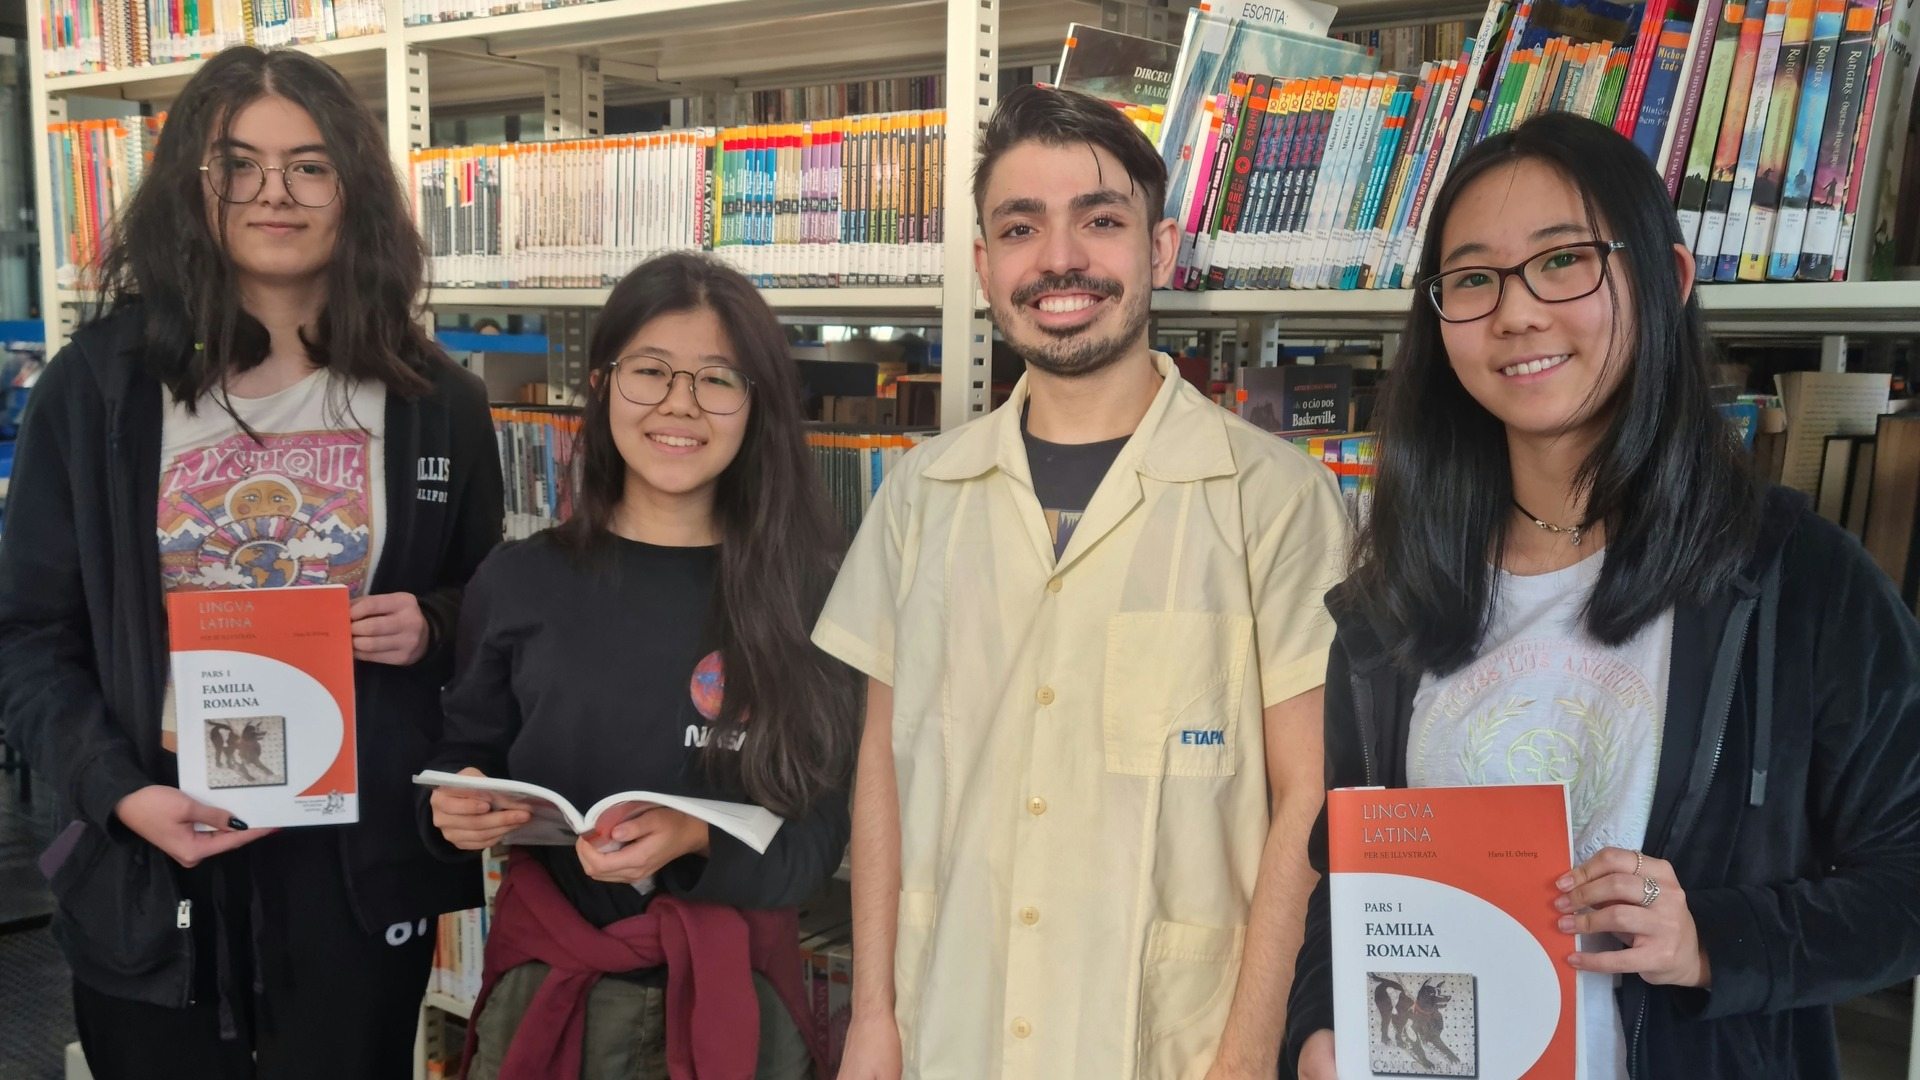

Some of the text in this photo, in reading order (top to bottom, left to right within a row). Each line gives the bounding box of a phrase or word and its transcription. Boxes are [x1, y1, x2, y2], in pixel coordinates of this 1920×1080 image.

[1242, 3, 1288, 25] ESCRITA:
[1706, 17, 1714, 26] AS
[1701, 28, 1711, 48] MAIS
[1660, 60, 1679, 71] Ende
[1694, 49, 1706, 73] BELAS
[1809, 43, 1831, 89] RANGERS
[1133, 66, 1172, 83] DIRCEU
[1841, 48, 1862, 96] RANGERS
[1444, 73, 1461, 106] LUÍS DI
[1559, 68, 1573, 101] Ivanhoe
[1684, 74, 1701, 116] HISTÓRIAS
[1269, 99, 1277, 111] 10
[1680, 117, 1689, 133] DAS
[1327, 127, 1339, 151] Michael
[1340, 126, 1352, 149] Michael
[1357, 126, 1369, 150] Michael
[1676, 134, 1685, 149] MIL
[695, 148, 703, 197] EVOLUÇÃO
[1422, 148, 1438, 182] ASFALTO
[1669, 157, 1679, 176] UMA
[1418, 182, 1427, 195] NO
[1408, 195, 1423, 227] OMBRAS
[702, 197, 711, 246] VARGAS
[1302, 398, 1335, 409] O CÃO DOS
[1292, 410, 1336, 427] Baskerville
[163, 444, 365, 498] MYSTIQUE
[417, 457, 450, 481] LLIS
[199, 600, 255, 614] LINGVA
[200, 617, 253, 630] LATINA
[201, 670, 223, 678] PARS
[1508, 655, 1550, 674] LOS
[1562, 655, 1637, 709] ANGELES
[202, 683, 255, 694] FAMILIA
[203, 697, 260, 709] ROMANA
[1181, 729, 1226, 746] ETAPA
[1362, 802, 1434, 820] LINGVA
[1363, 826, 1433, 843] LATINA
[1363, 850, 1438, 859] PER SE ILLVSTRATA
[1488, 850, 1504, 858] Hans
[1364, 902, 1403, 913] PARS I
[1365, 922, 1435, 936] FAMILIA
[1366, 944, 1442, 958] ROMANA
